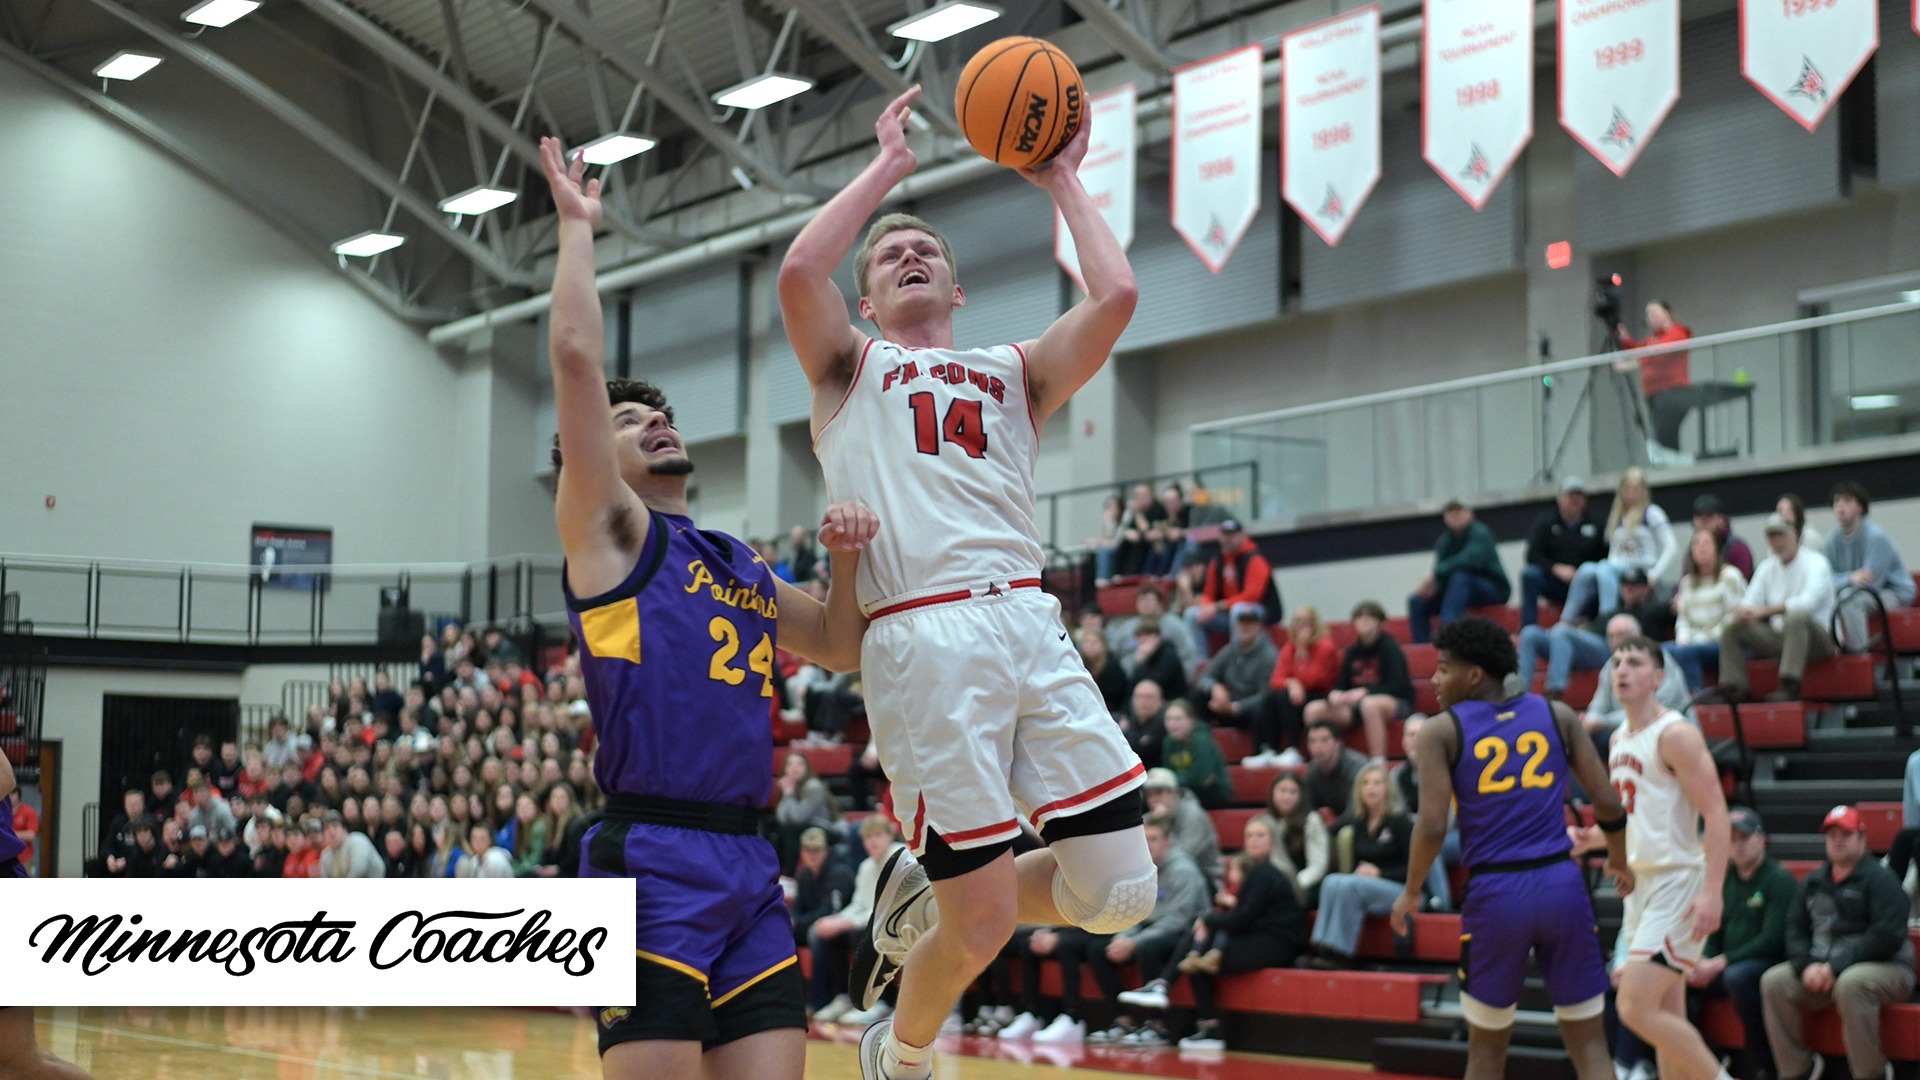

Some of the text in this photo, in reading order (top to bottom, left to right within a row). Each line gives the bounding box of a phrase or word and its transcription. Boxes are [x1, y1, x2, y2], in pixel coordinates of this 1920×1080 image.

[1594, 38, 1645, 70] 1999
[1015, 92, 1048, 153] NCAA
[882, 360, 1006, 404] FACONS
[908, 391, 988, 459] 14
[708, 615, 775, 698] 24
[1473, 731, 1554, 794] 22
